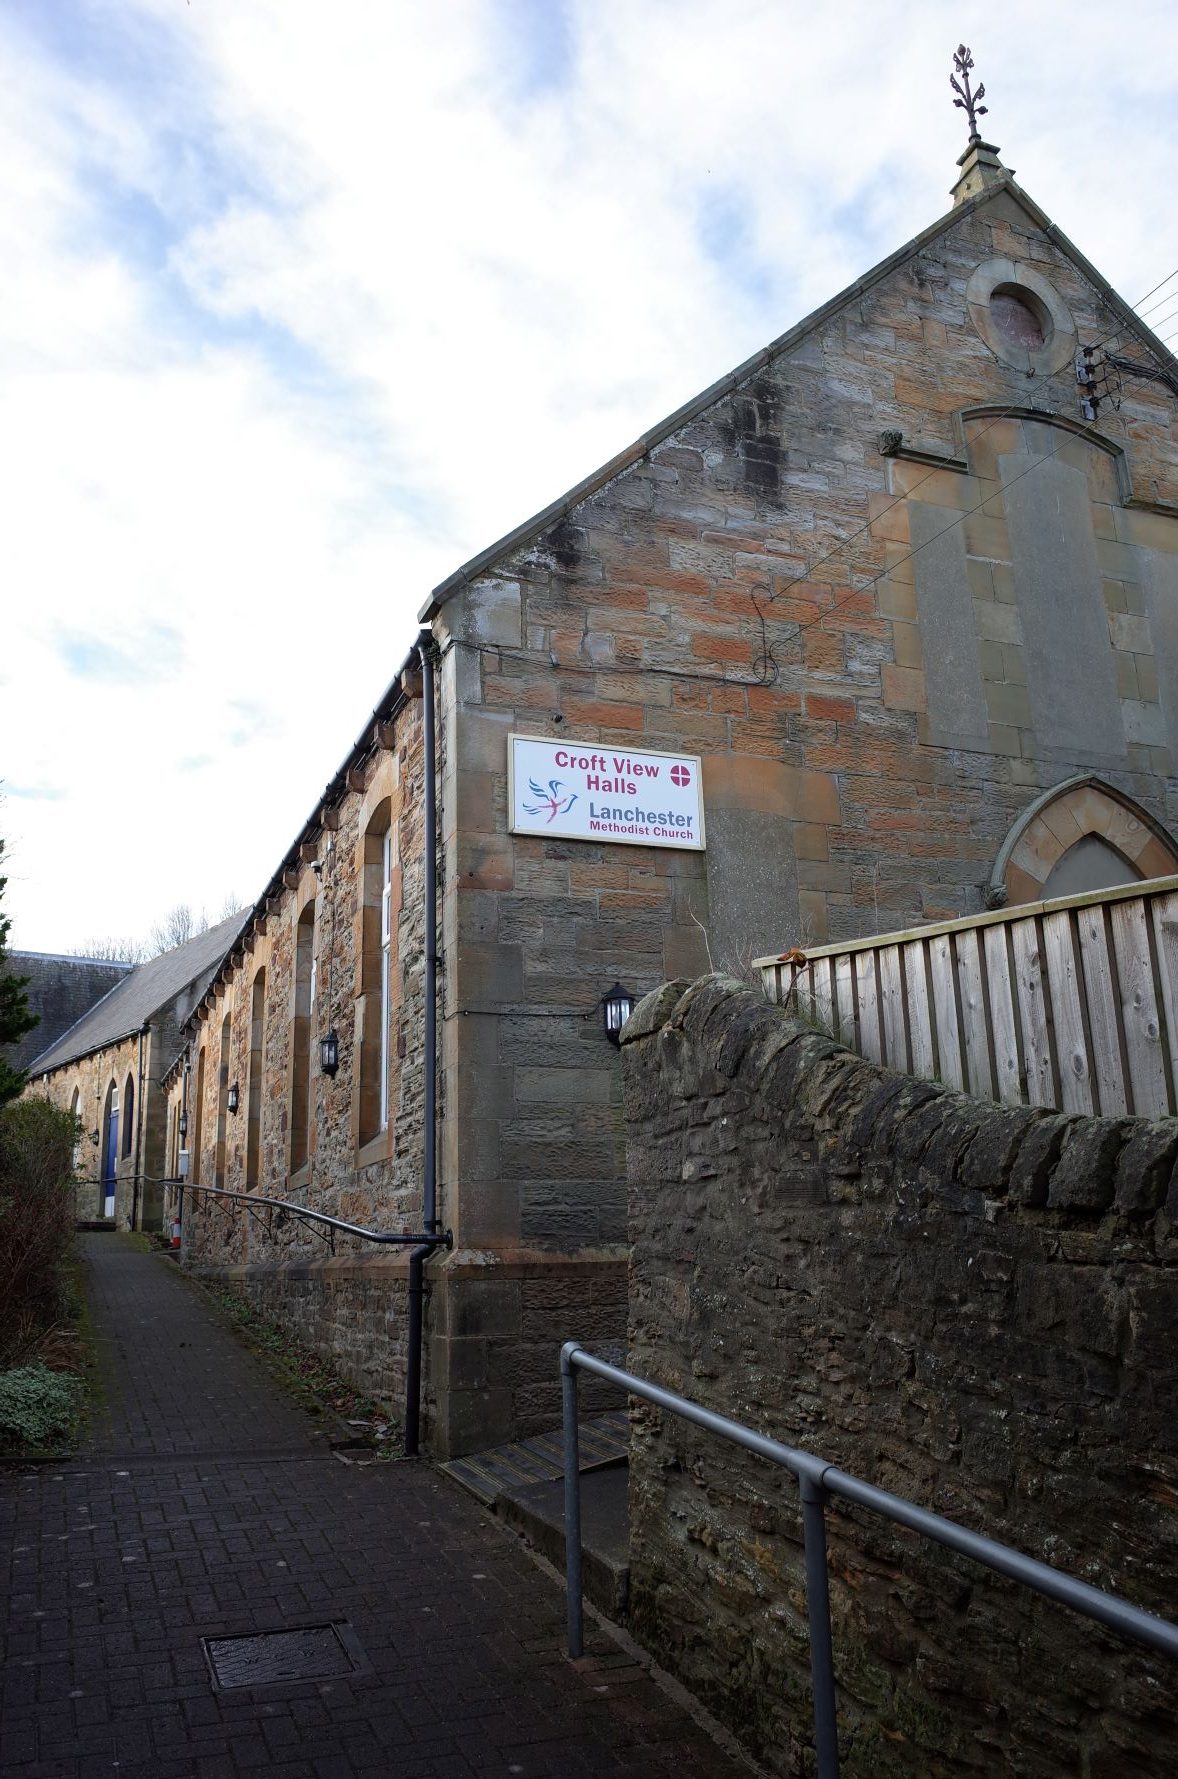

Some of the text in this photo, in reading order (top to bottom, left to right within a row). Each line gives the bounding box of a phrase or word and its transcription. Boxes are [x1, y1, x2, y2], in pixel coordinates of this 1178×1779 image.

[555, 751, 659, 778] Croft View
[587, 774, 637, 795] Halls
[590, 802, 692, 827] Lanchester
[590, 820, 693, 839] Methodist Church
